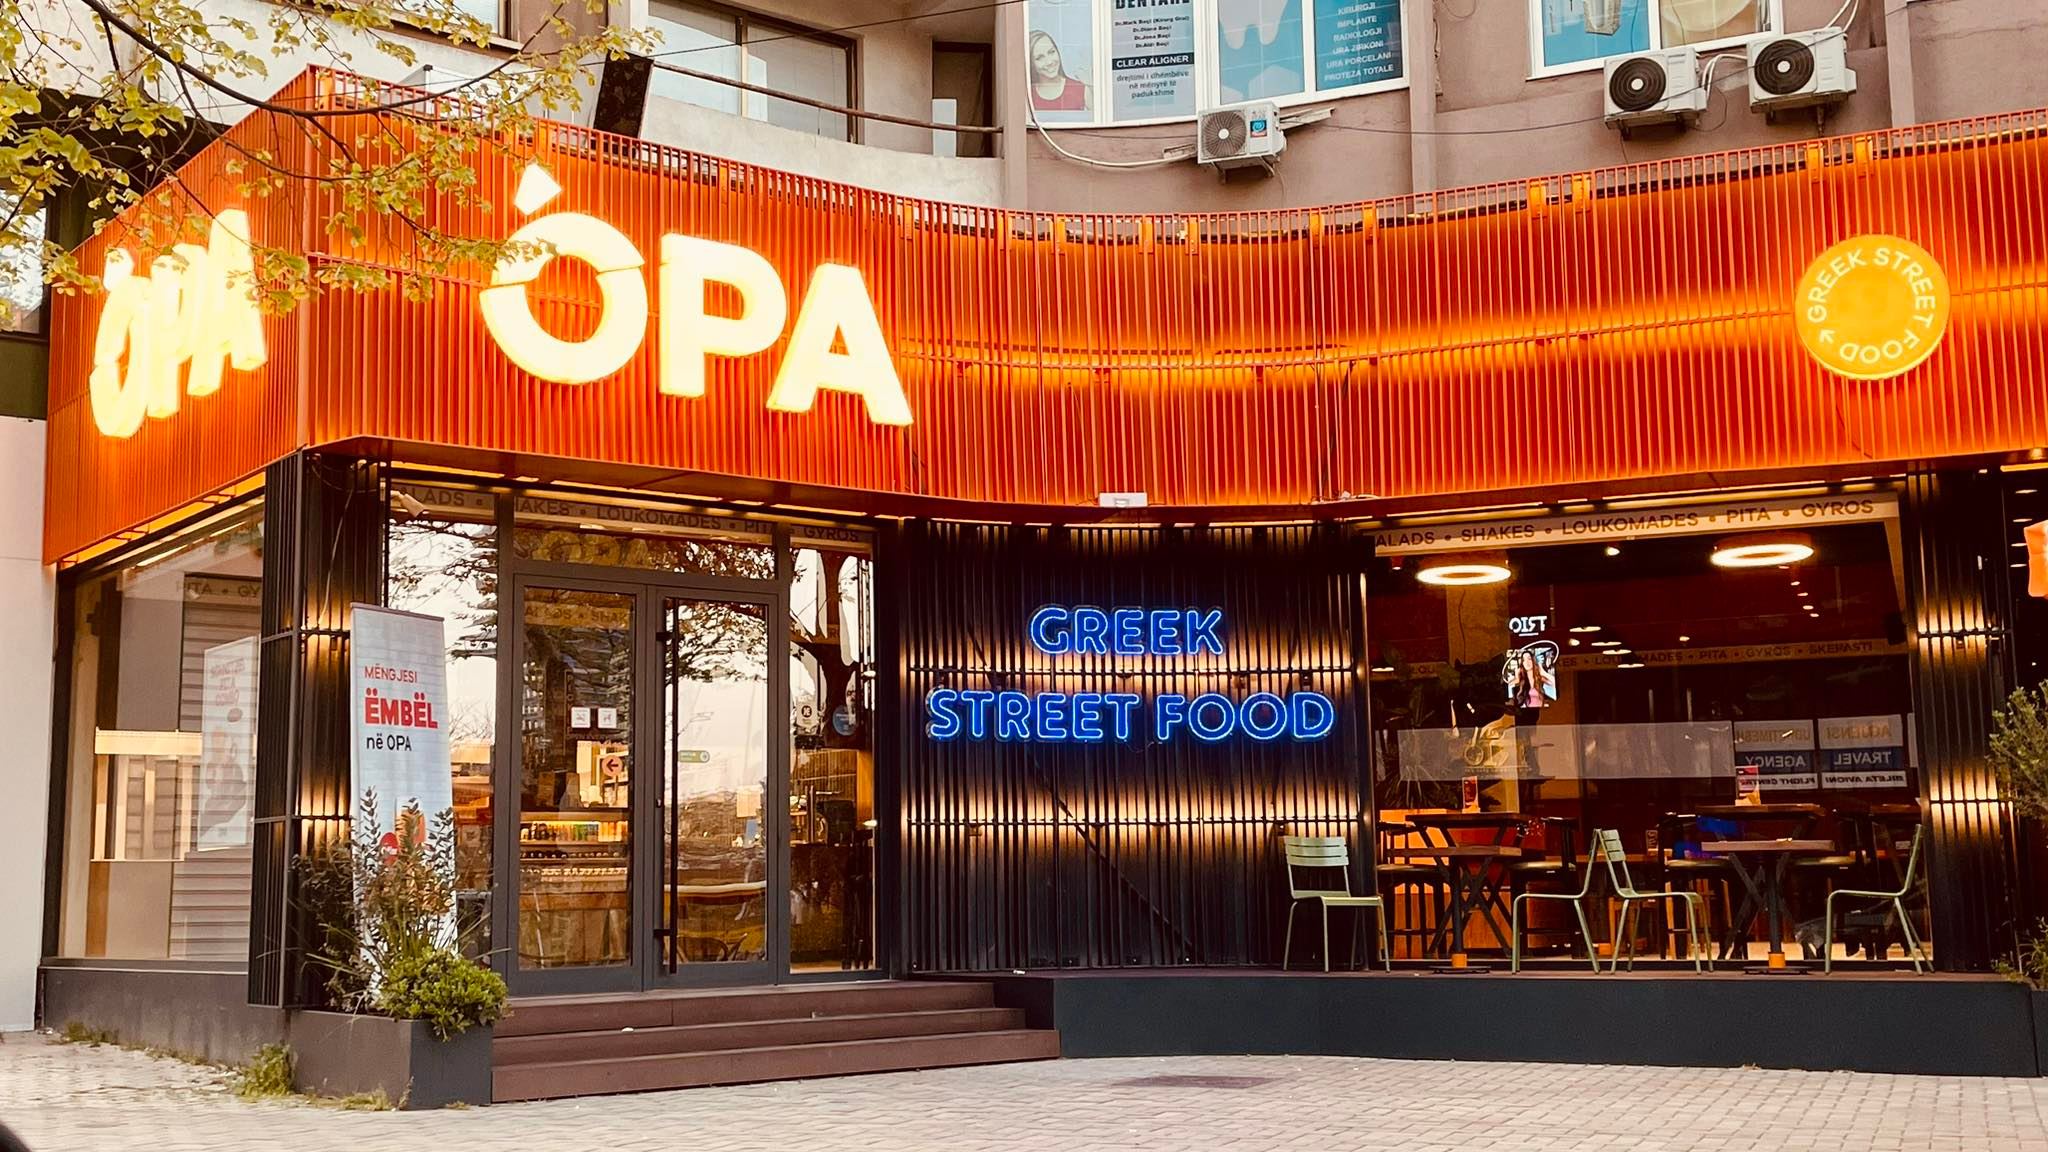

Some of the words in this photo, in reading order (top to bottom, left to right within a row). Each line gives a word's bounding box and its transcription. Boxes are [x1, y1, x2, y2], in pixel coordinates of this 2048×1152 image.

[1333, 27, 1382, 41] RADIOLOGJI
[1116, 58, 1147, 68] CLEAR
[1149, 55, 1189, 65] ALIGNER
[1324, 70, 1361, 80] PROTEZA
[1364, 64, 1394, 75] TOTALE
[1345, 51, 1392, 65] PORCELANI
[1807, 248, 1866, 323] GREEK
[1873, 247, 1936, 328] STREET
[1839, 329, 1920, 364] FOOD
[597, 507, 721, 530] LOUKOMADES
[744, 520, 775, 535] PIT
[803, 527, 860, 543] GYROS
[1376, 530, 1435, 548] ALADS
[1461, 524, 1535, 543] SHAKES
[1562, 512, 1698, 535] LOUKOMADES
[1727, 507, 1771, 524] PITA
[1801, 499, 1874, 518] GYROS
[1029, 606, 1224, 656] GREEK
[1745, 646, 1791, 658] GYROS
[364, 663, 418, 683] MËNGJESI
[365, 687, 438, 729] ËMBËL
[928, 689, 1140, 740] STREET
[1156, 692, 1335, 741] FOOD
[366, 733, 383, 750] në
[387, 734, 412, 751] OPA
